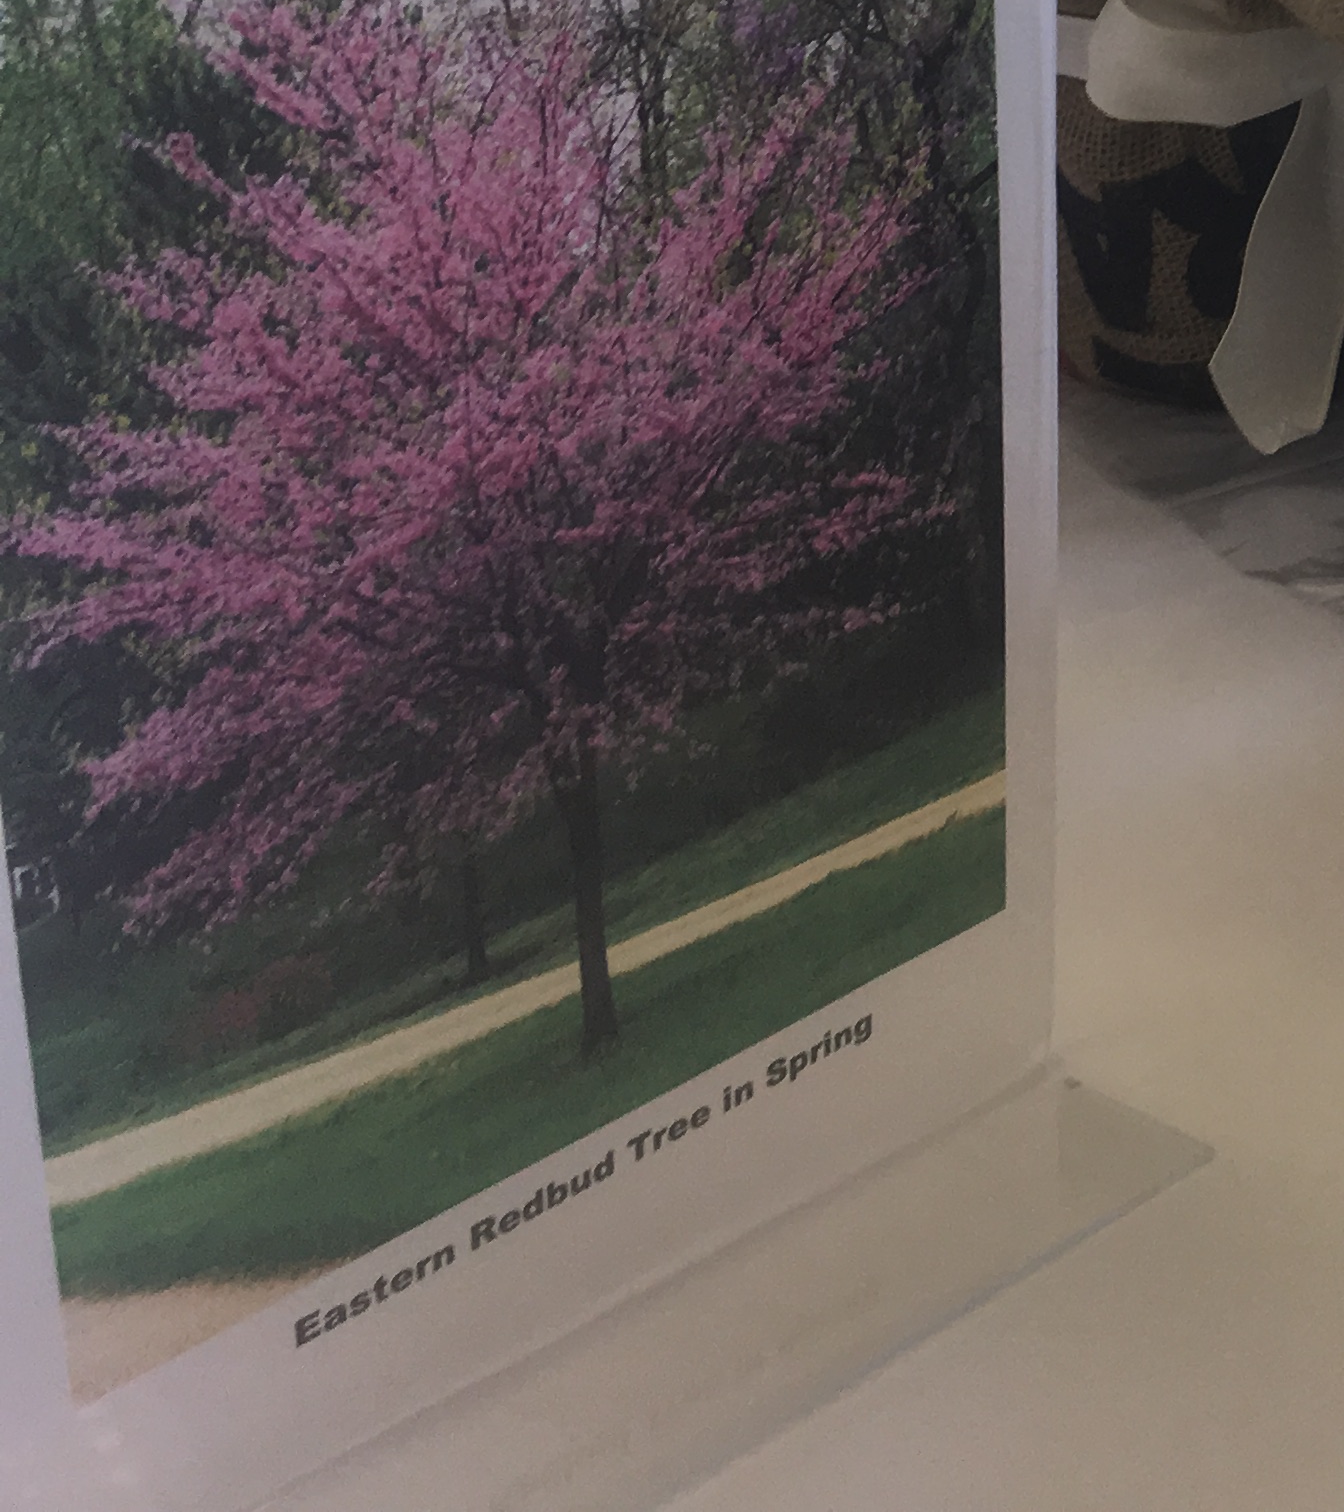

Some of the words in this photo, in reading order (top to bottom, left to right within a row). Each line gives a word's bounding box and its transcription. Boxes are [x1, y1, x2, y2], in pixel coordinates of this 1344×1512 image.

[295, 1242, 456, 1348] Eastern
[469, 1150, 616, 1250] Redbud
[626, 1103, 713, 1164] Tree
[721, 1081, 754, 1115] in
[764, 1013, 874, 1087] Spring
